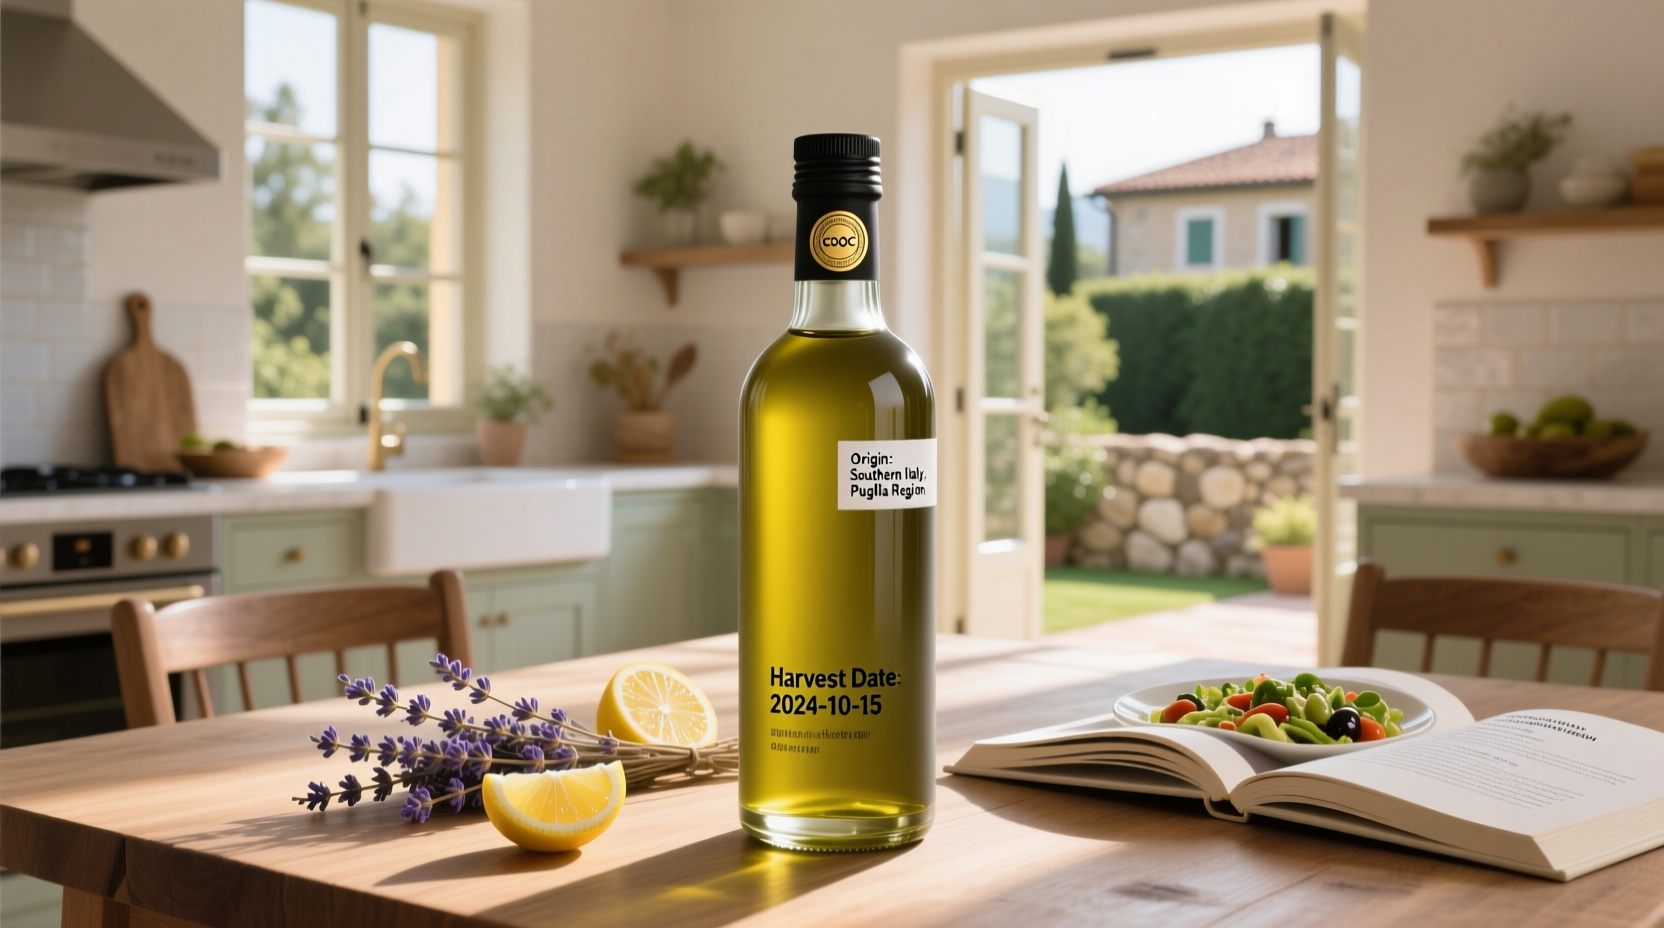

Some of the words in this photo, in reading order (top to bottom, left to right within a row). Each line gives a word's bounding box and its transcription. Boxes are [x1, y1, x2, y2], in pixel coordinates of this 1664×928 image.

[823, 236, 856, 247] CDOC
[850, 451, 893, 468] Origin:
[850, 467, 902, 481] Southern
[891, 483, 926, 500] Region
[770, 666, 847, 689] Harvest
[851, 667, 902, 688] Date:
[770, 693, 882, 716] 2024-10-15
